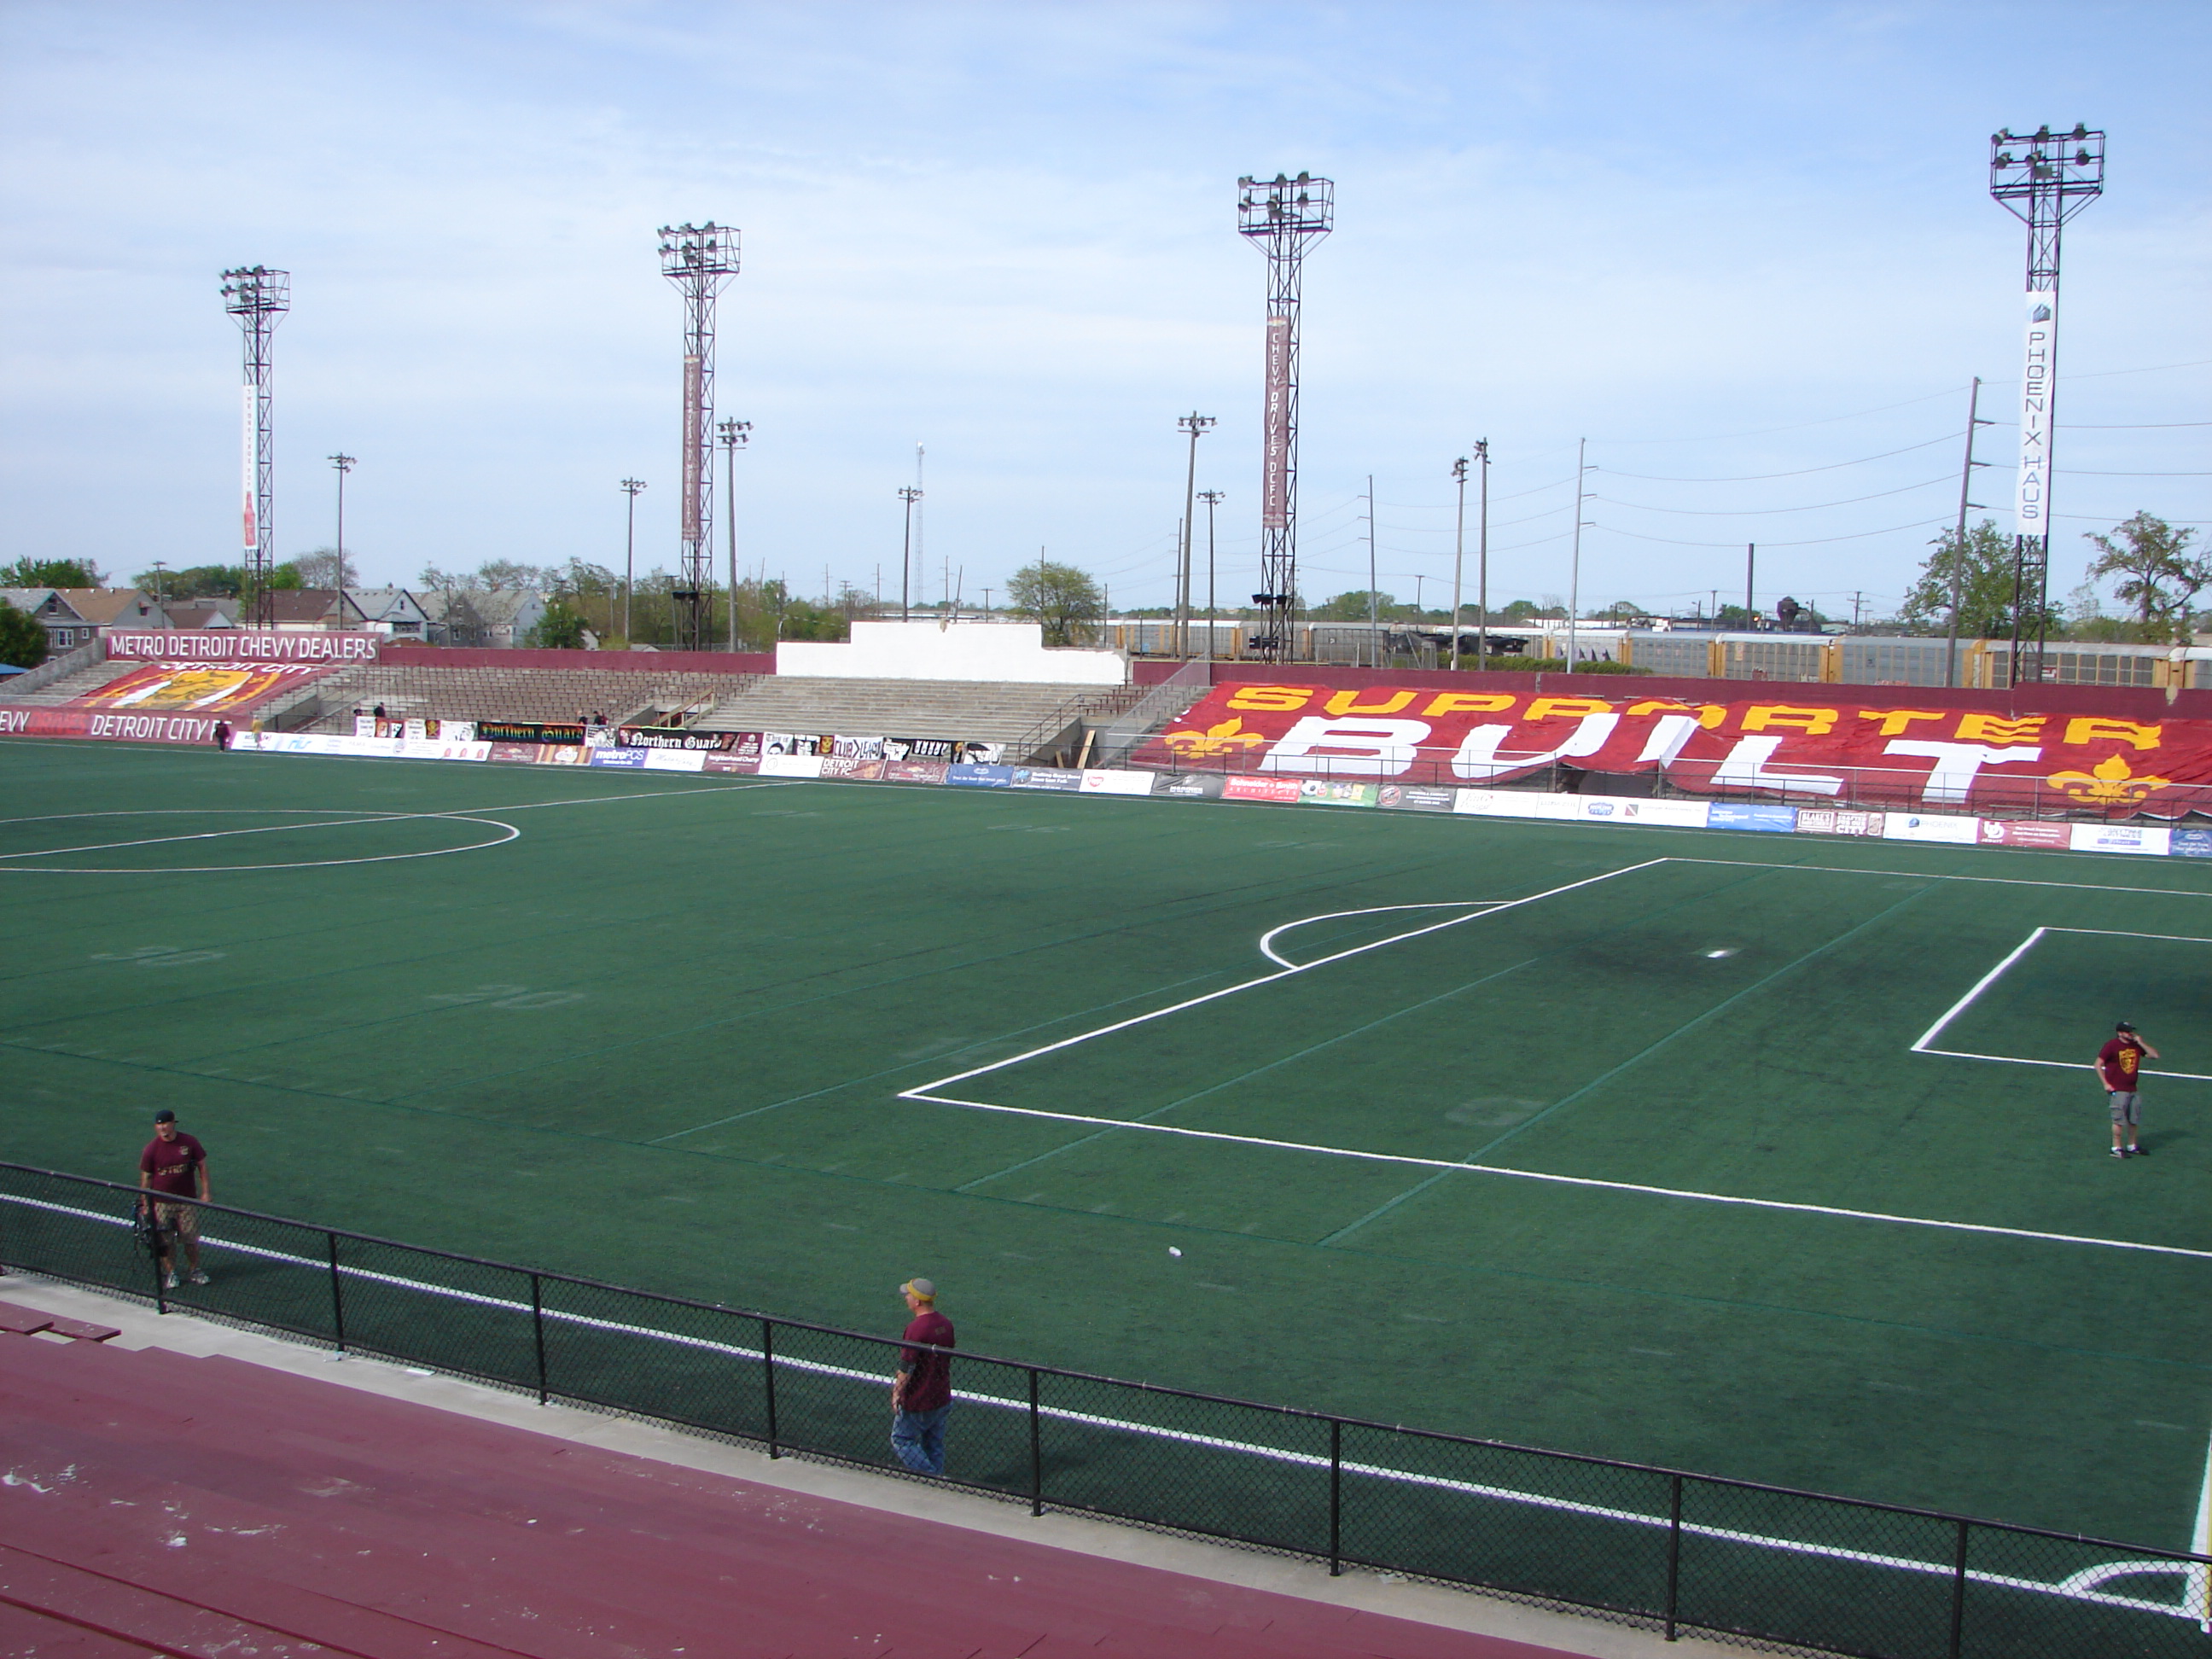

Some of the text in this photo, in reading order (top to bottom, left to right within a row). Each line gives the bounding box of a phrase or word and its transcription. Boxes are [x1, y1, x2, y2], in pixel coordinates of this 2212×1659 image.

[1271, 333, 1279, 387] CHEVY
[1269, 393, 1279, 457] DRIVES
[2022, 332, 2046, 519] PHOENIX HAUS
[111, 635, 377, 660] METRO DETROIT CHEVY DEALERS
[261, 664, 314, 675] CITY
[90, 713, 168, 739] DETROIT
[166, 718, 210, 741] CITY
[1226, 686, 2162, 751] SUPPORTER
[631, 731, 682, 749] Northern
[684, 733, 723, 749] Guard
[596, 749, 645, 760] metroPCS
[823, 758, 859, 769] DETROIT
[1257, 713, 2042, 804] BUILT
[821, 766, 852, 776] CITY FC
[1836, 824, 1866, 835] CITY
